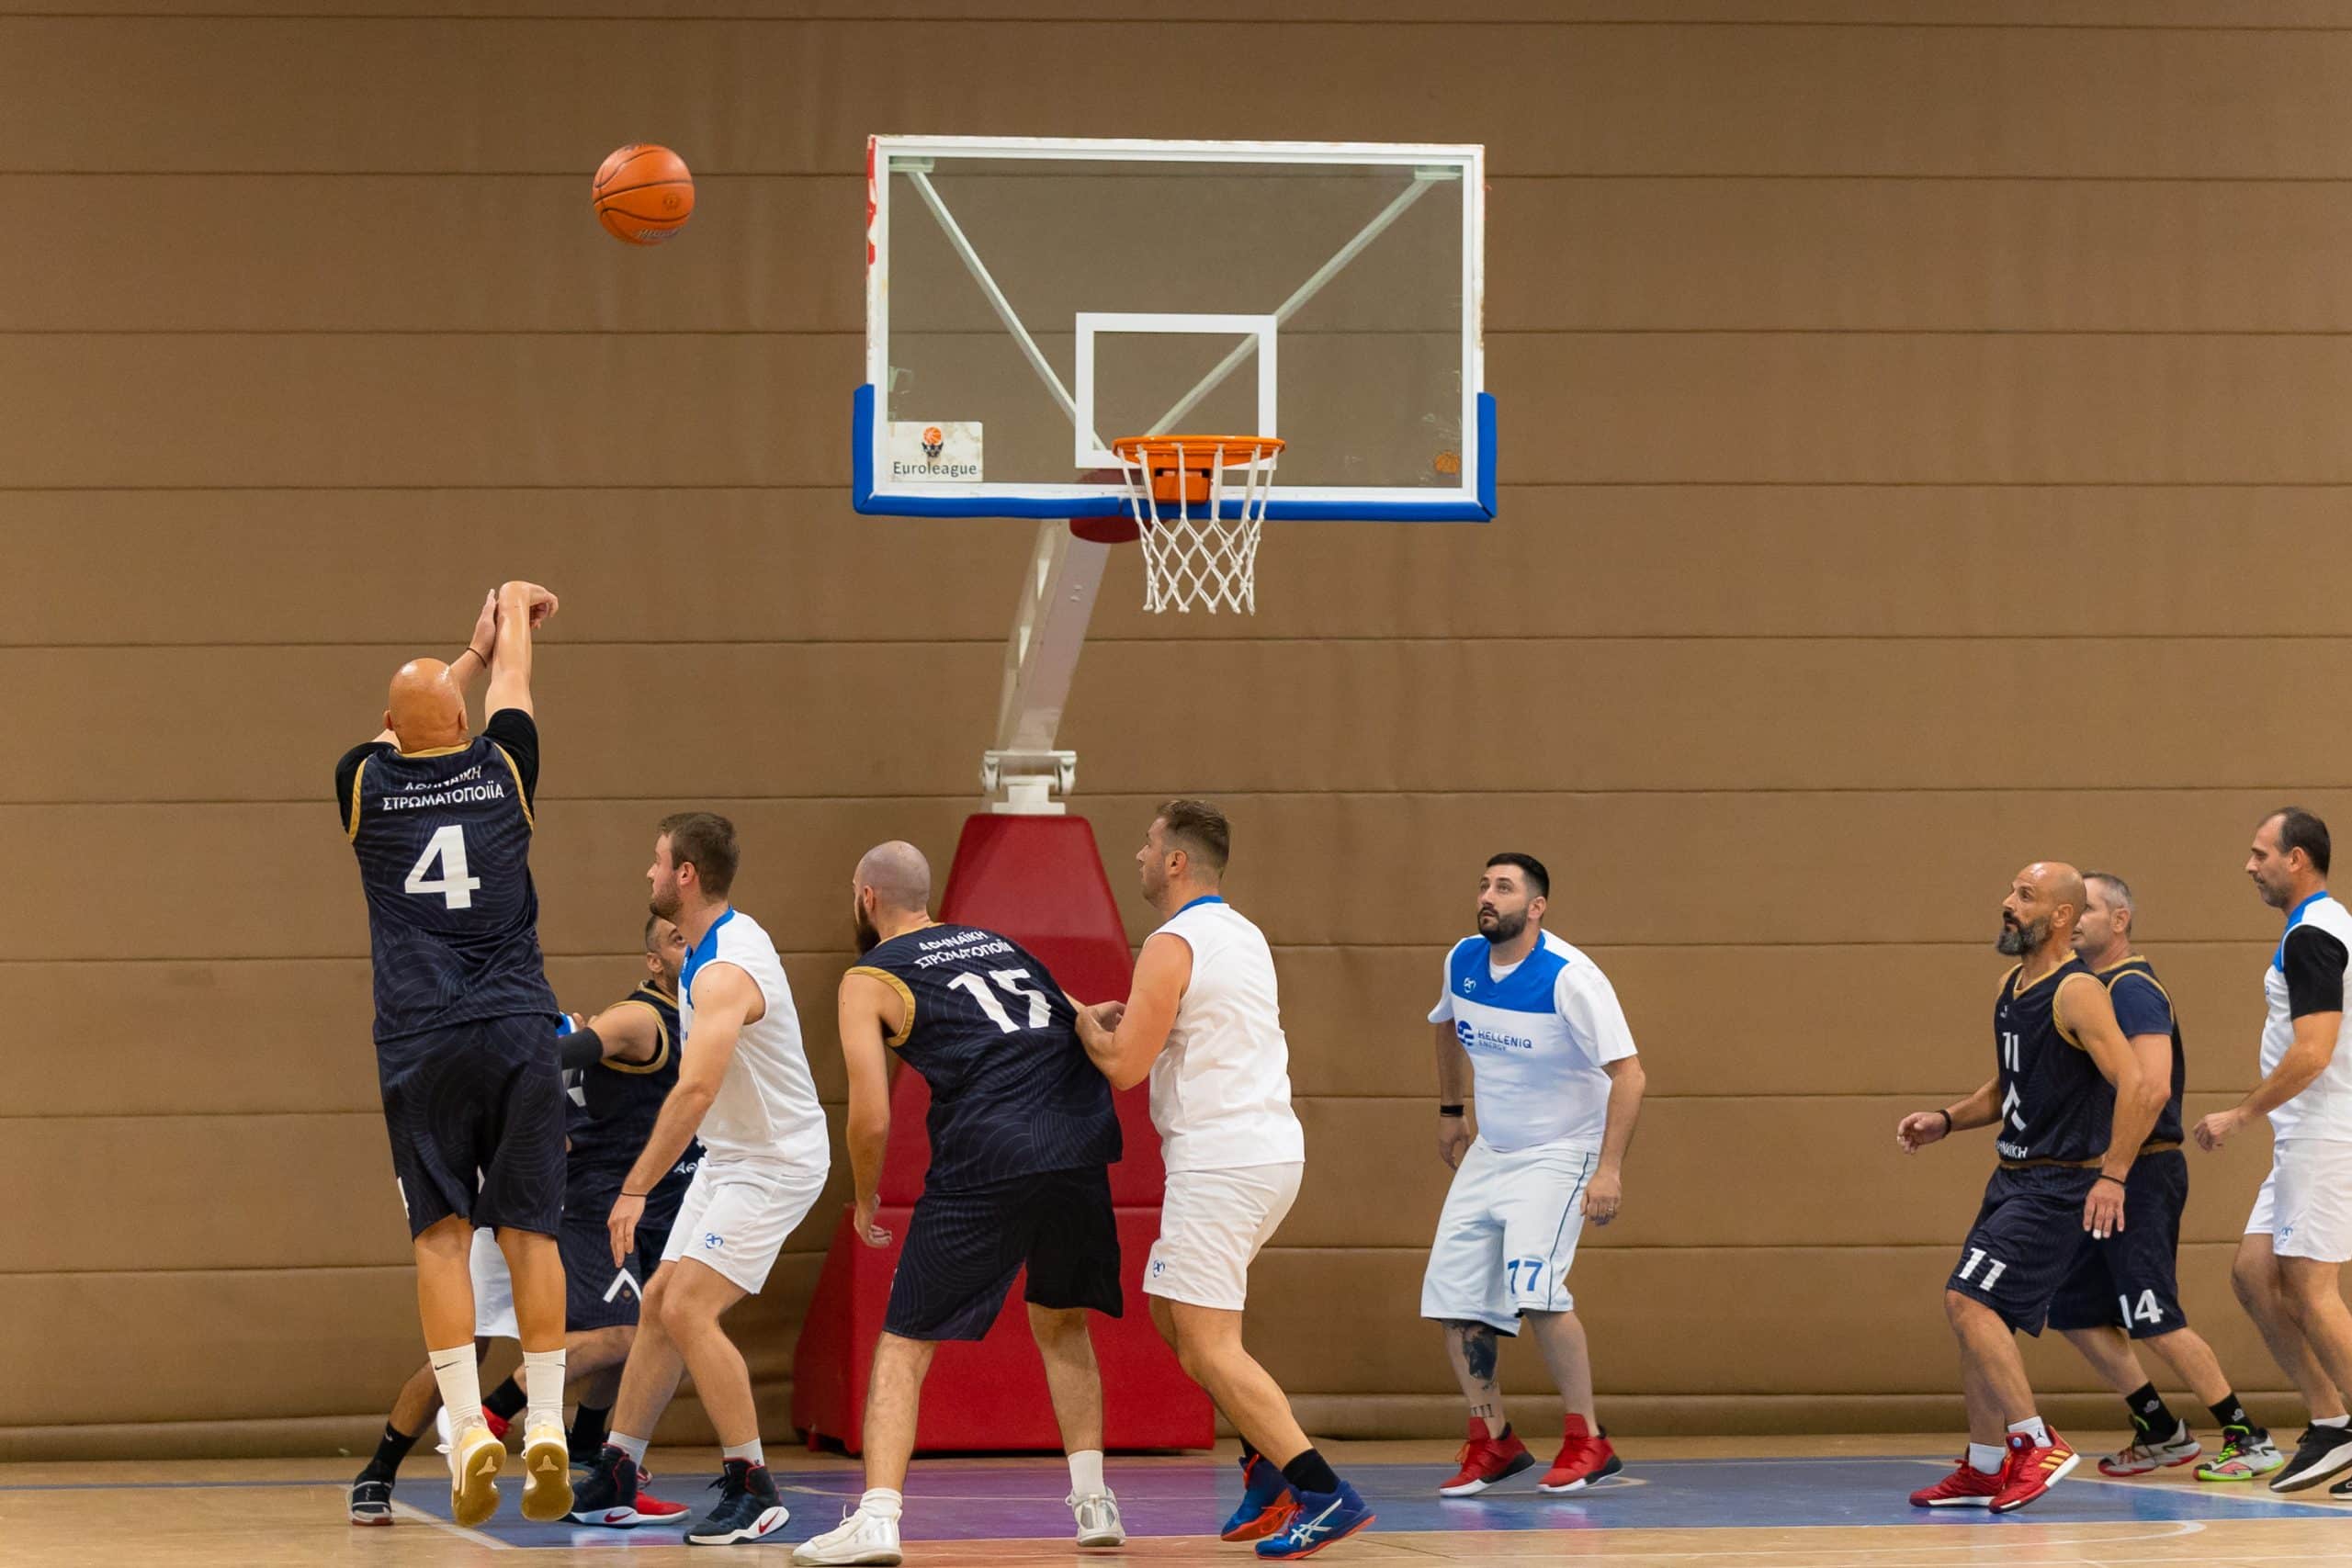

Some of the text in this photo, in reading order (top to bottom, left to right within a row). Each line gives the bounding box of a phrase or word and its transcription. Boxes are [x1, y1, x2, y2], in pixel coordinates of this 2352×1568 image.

[893, 461, 978, 478] Euroleague
[382, 781, 504, 811] ΣΤΡΩΜΑΤΟΠΟΙΪΑ
[404, 824, 481, 909] 4
[947, 968, 1052, 1034] 15
[1477, 1029, 1532, 1049] HELLENIQ
[2002, 1032, 2020, 1073] 11
[1958, 1247, 2007, 1292] 11
[2119, 1289, 2164, 1329] 14
